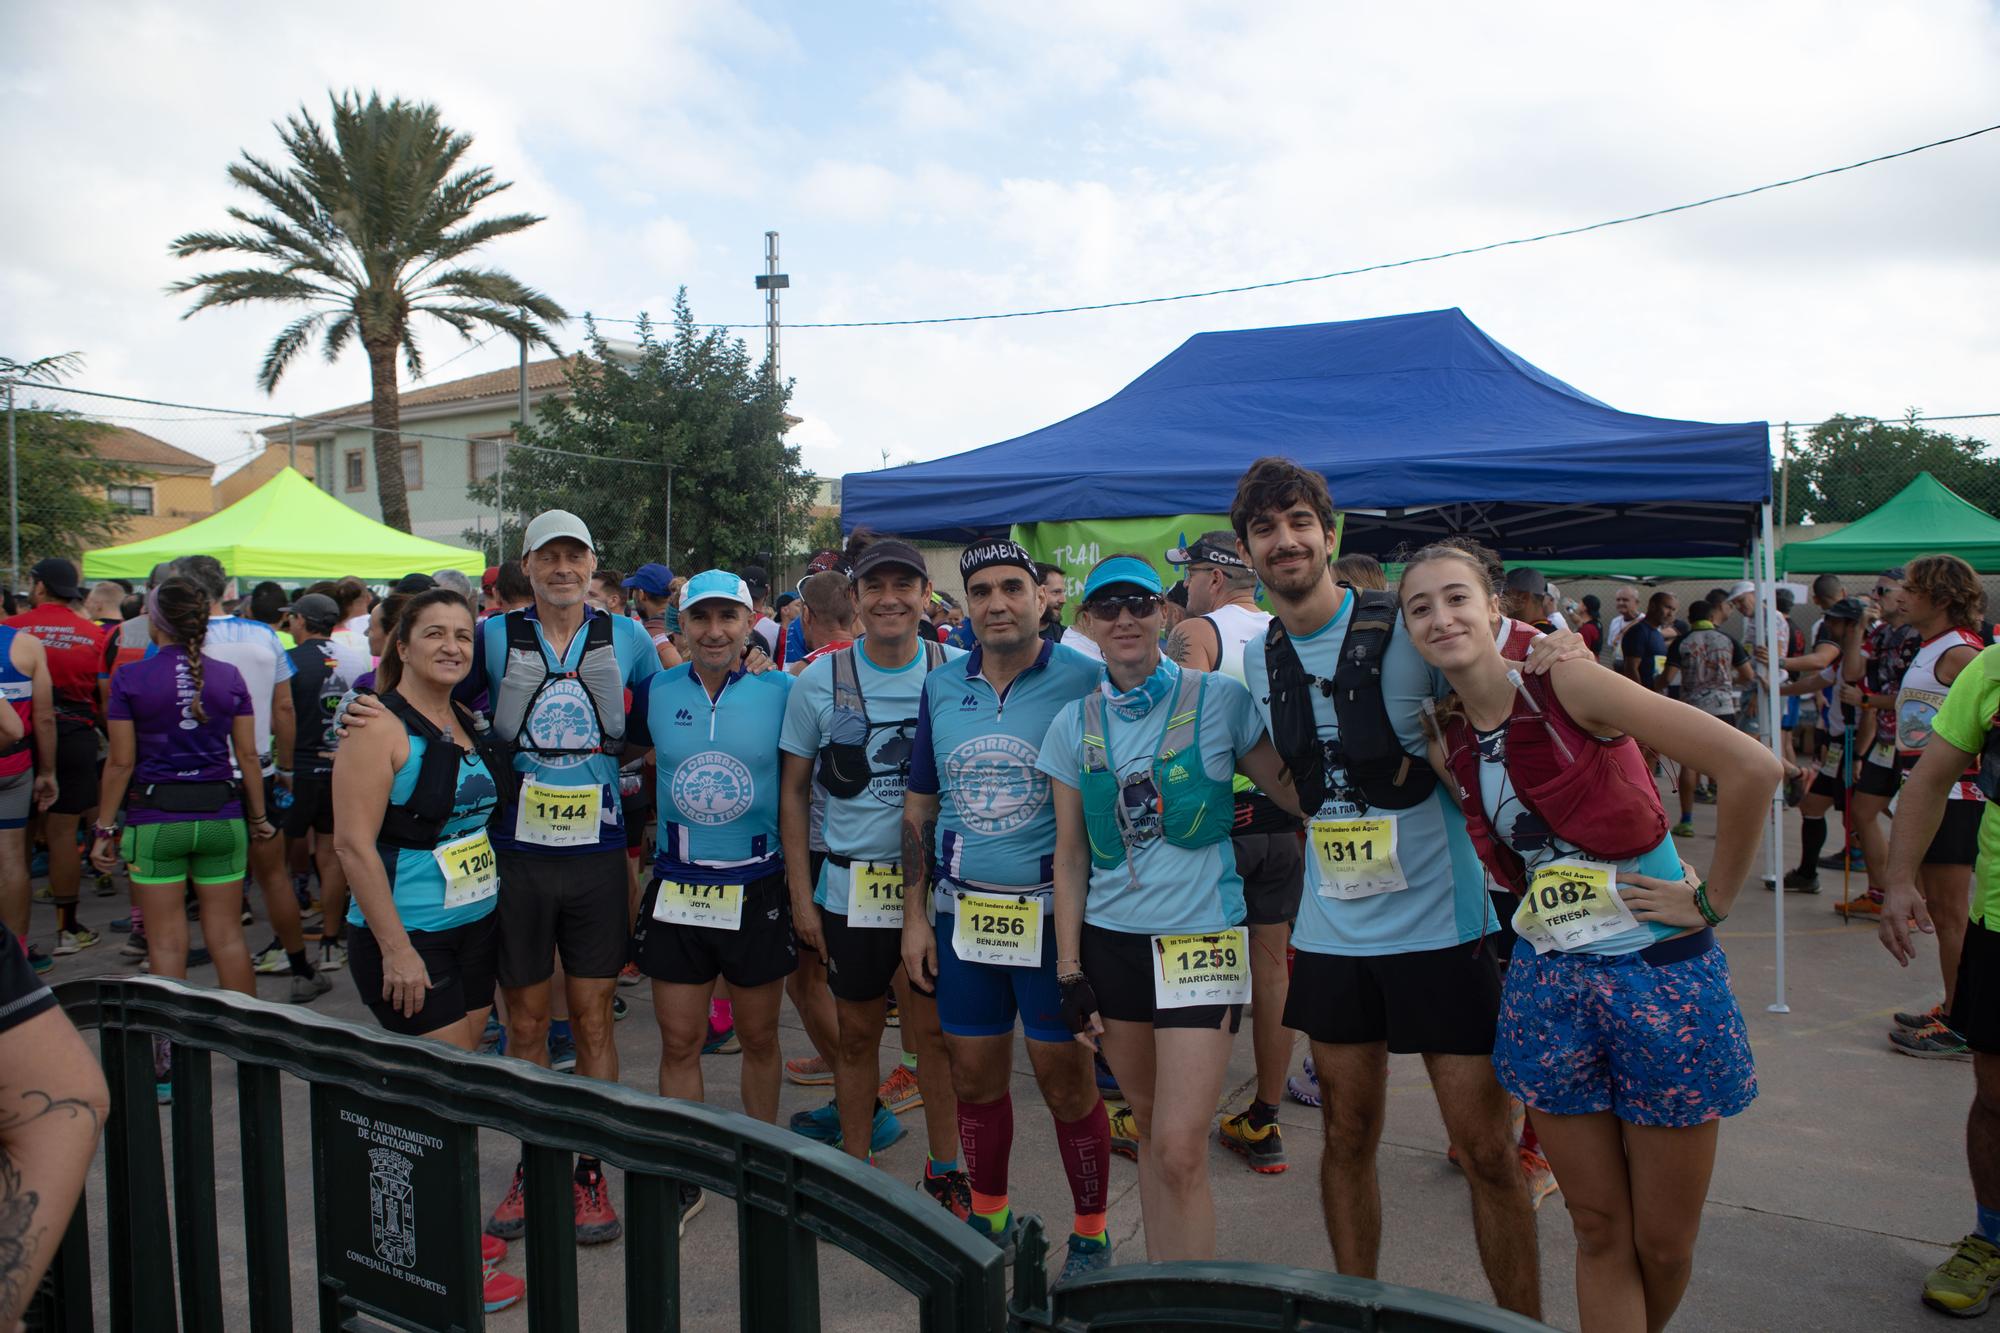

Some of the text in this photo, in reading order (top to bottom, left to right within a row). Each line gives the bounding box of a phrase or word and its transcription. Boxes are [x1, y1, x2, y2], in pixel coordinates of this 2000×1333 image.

[961, 544, 1019, 570] KAMUABU
[536, 802, 587, 820] 1144
[1323, 840, 1373, 862] 1311
[869, 882, 904, 899] 110
[1528, 881, 1597, 914] 1082
[690, 901, 711, 909] JOTA
[971, 914, 1025, 935] 1256
[1545, 909, 1590, 927] TERESA
[976, 938, 1019, 948] BENJAMIN
[1177, 948, 1237, 970] 1259
[1179, 974, 1239, 985] MARICARMEN
[340, 1109, 443, 1150] EXCMO. AYUNTAMIENTO
[358, 1127, 425, 1157] DE CARTAGENA
[1069, 1136, 1101, 1208] kalenji
[346, 1249, 447, 1295] CONCEJALÍA DE DEPORTES
